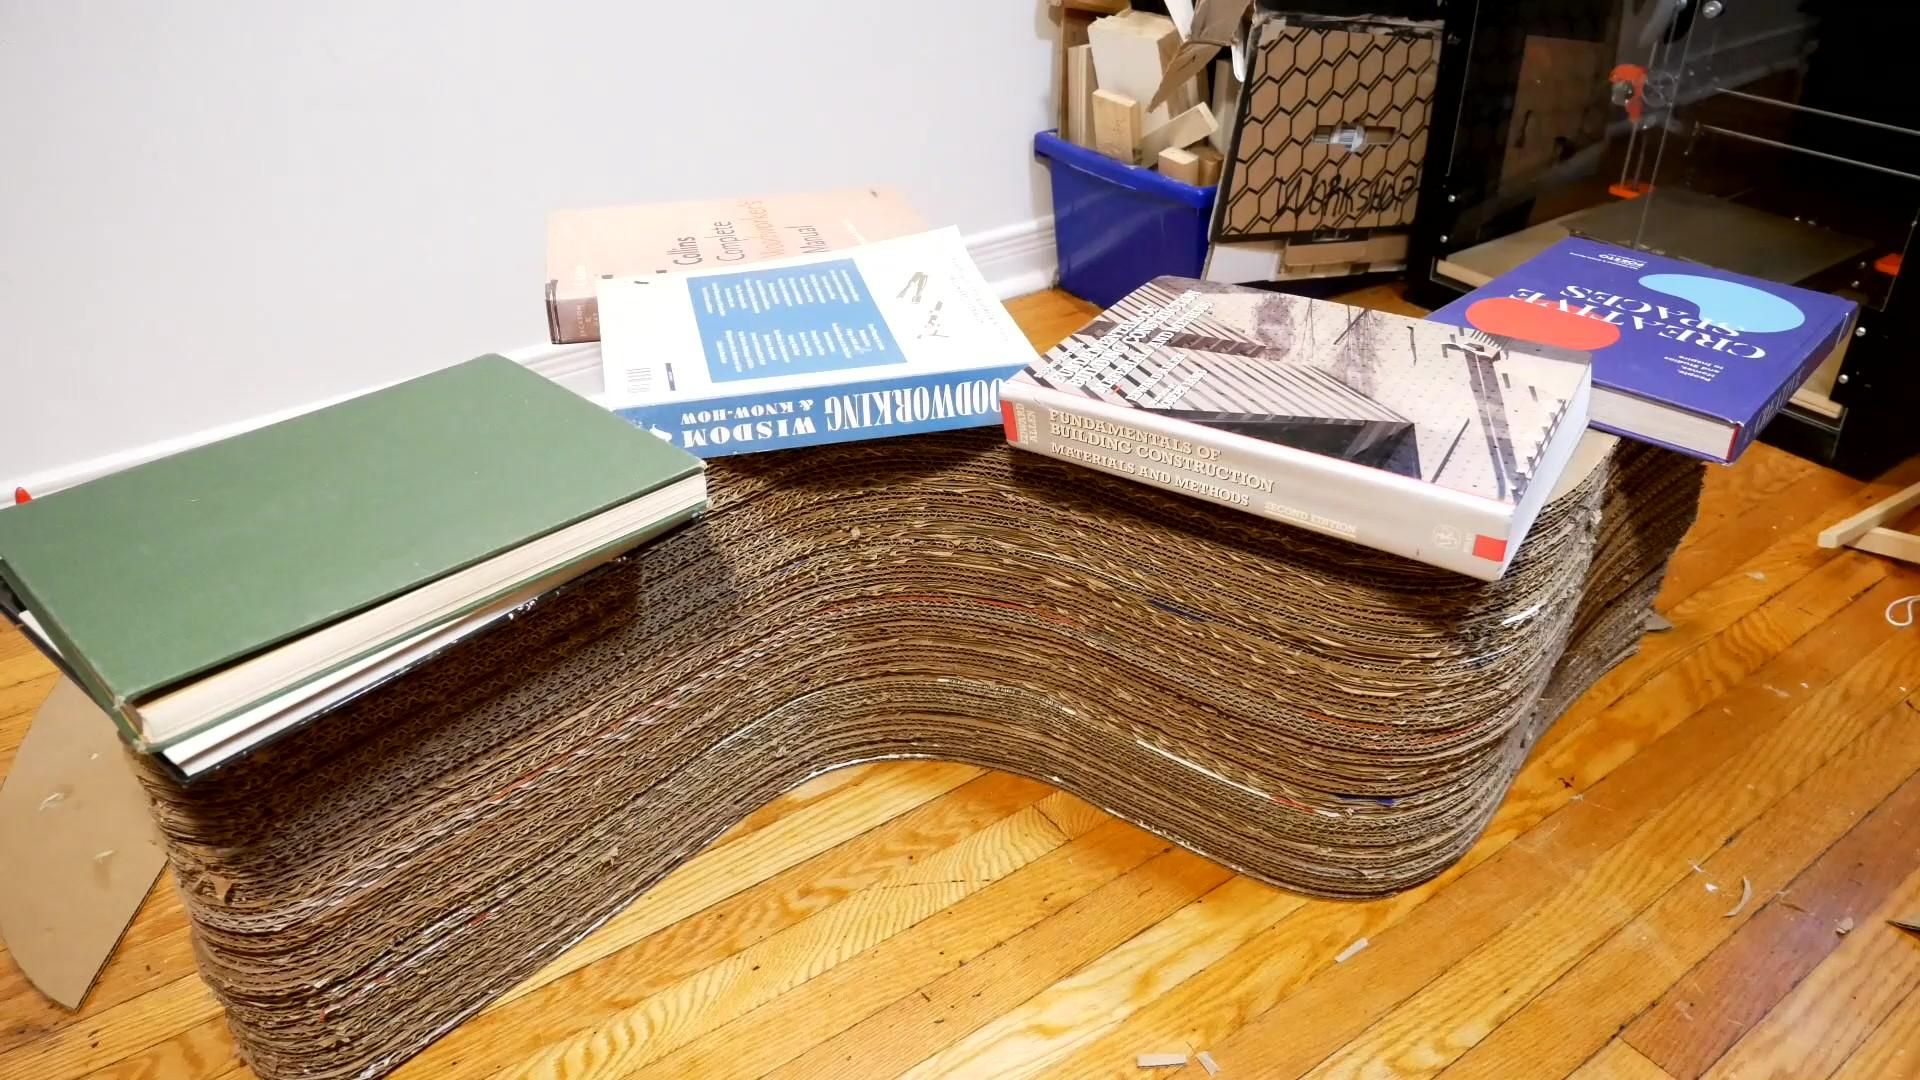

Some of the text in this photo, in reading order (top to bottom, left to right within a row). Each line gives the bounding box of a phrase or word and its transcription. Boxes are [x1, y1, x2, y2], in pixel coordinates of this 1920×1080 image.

[1277, 174, 1415, 218] WORKSHOP
[666, 236, 703, 265] Collins
[704, 220, 748, 262] Complete
[784, 225, 833, 254] Manual
[1510, 289, 1766, 360] CREATIVE
[1560, 285, 1741, 337] SPACES
[1048, 304, 1160, 383] FUNDAMENTALS OF
[1066, 289, 1202, 387] BUILDING CONSTRUCTION
[1146, 330, 1176, 350] AND
[681, 399, 814, 425] & KNOW-HOW
[824, 378, 1002, 432] OODWORKING
[682, 415, 817, 449] WISDOM
[1049, 409, 1222, 462] FUNDAMENTALS OF
[1050, 422, 1275, 494] BUILDING CONSTRUCTION
[1051, 443, 1249, 507] MATERIALS AND METHODS
[1264, 502, 1357, 534] SECOND EDITION
